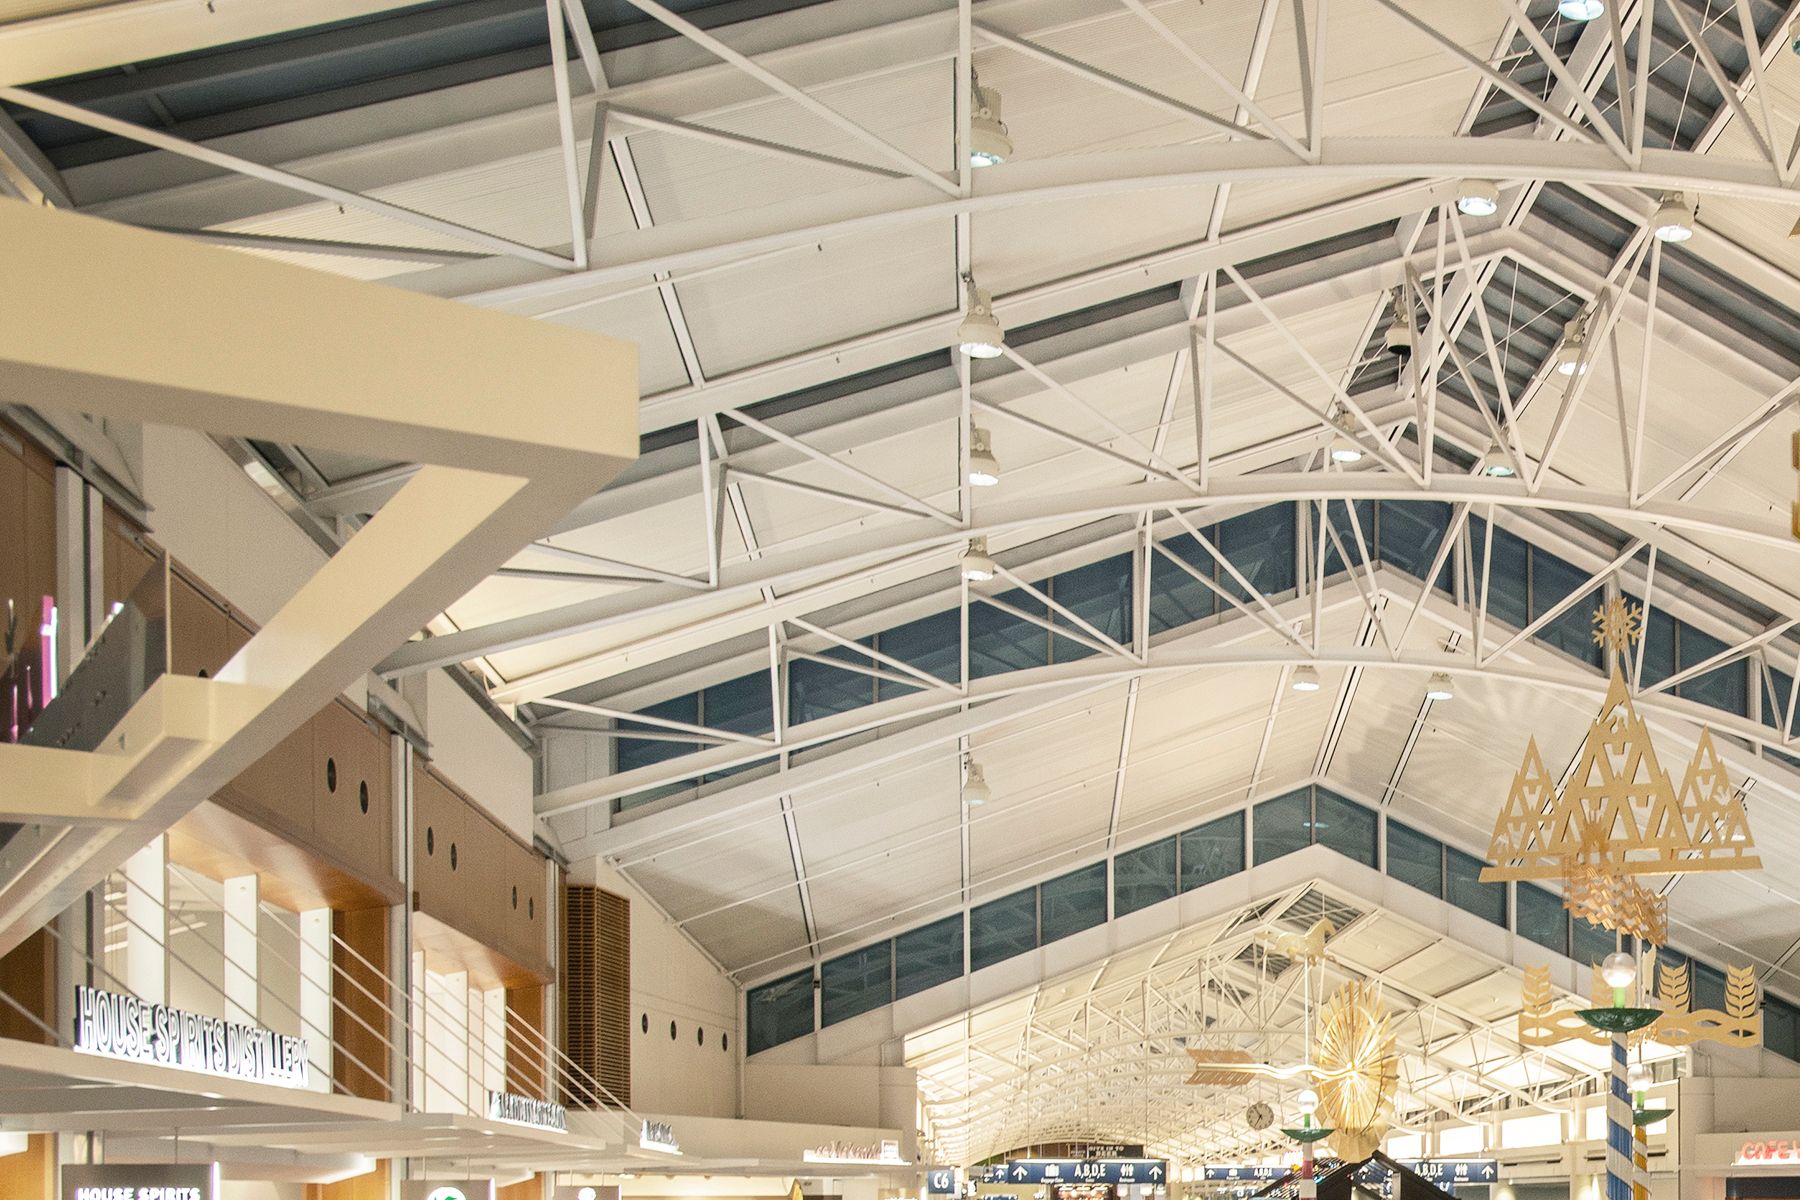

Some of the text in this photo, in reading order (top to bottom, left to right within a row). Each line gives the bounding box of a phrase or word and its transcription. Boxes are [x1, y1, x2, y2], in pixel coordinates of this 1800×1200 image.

[79, 985, 310, 1088] HOUSE SPIRITS DISTILLERY
[933, 1173, 948, 1188] C6
